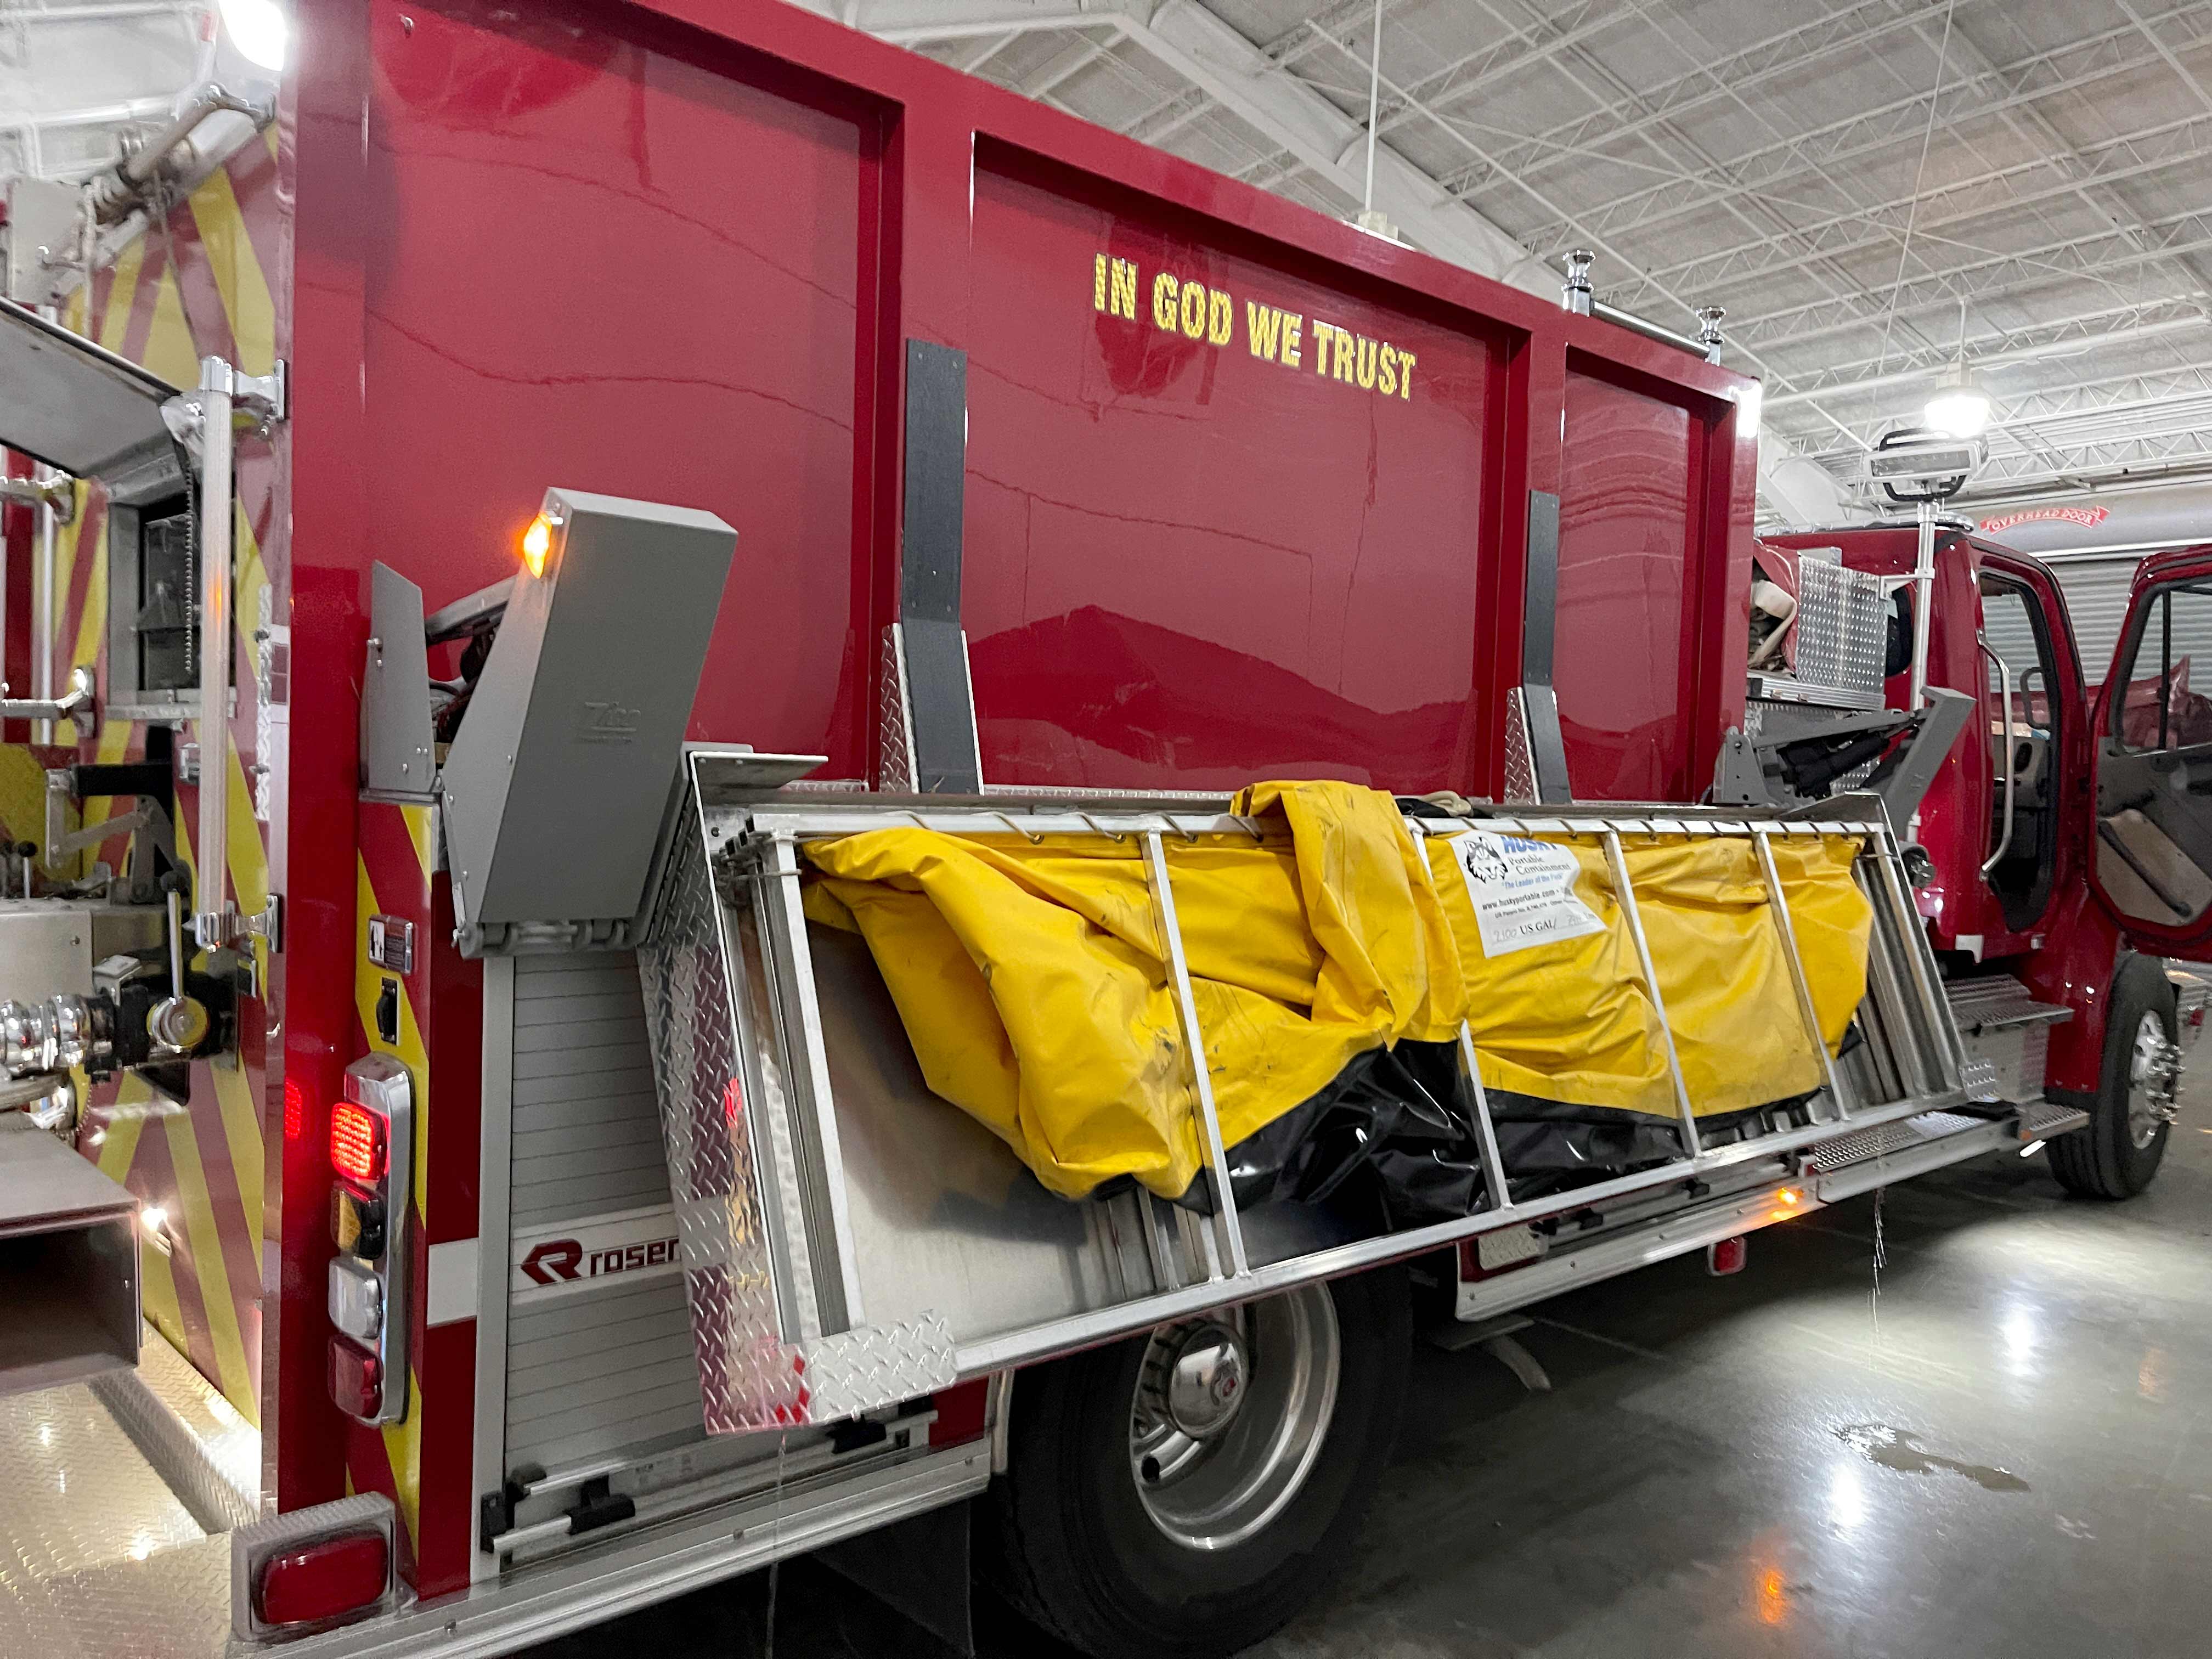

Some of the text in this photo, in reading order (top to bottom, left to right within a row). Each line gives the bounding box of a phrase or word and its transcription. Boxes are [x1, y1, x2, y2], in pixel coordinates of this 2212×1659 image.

[1094, 252, 1417, 402] IN GOD WE TRUST
[1991, 509, 2093, 531] OVERHEAD DOOR
[1508, 854, 1545, 866] Portable
[1515, 863, 1572, 876] Containment
[1519, 923, 1534, 935] US
